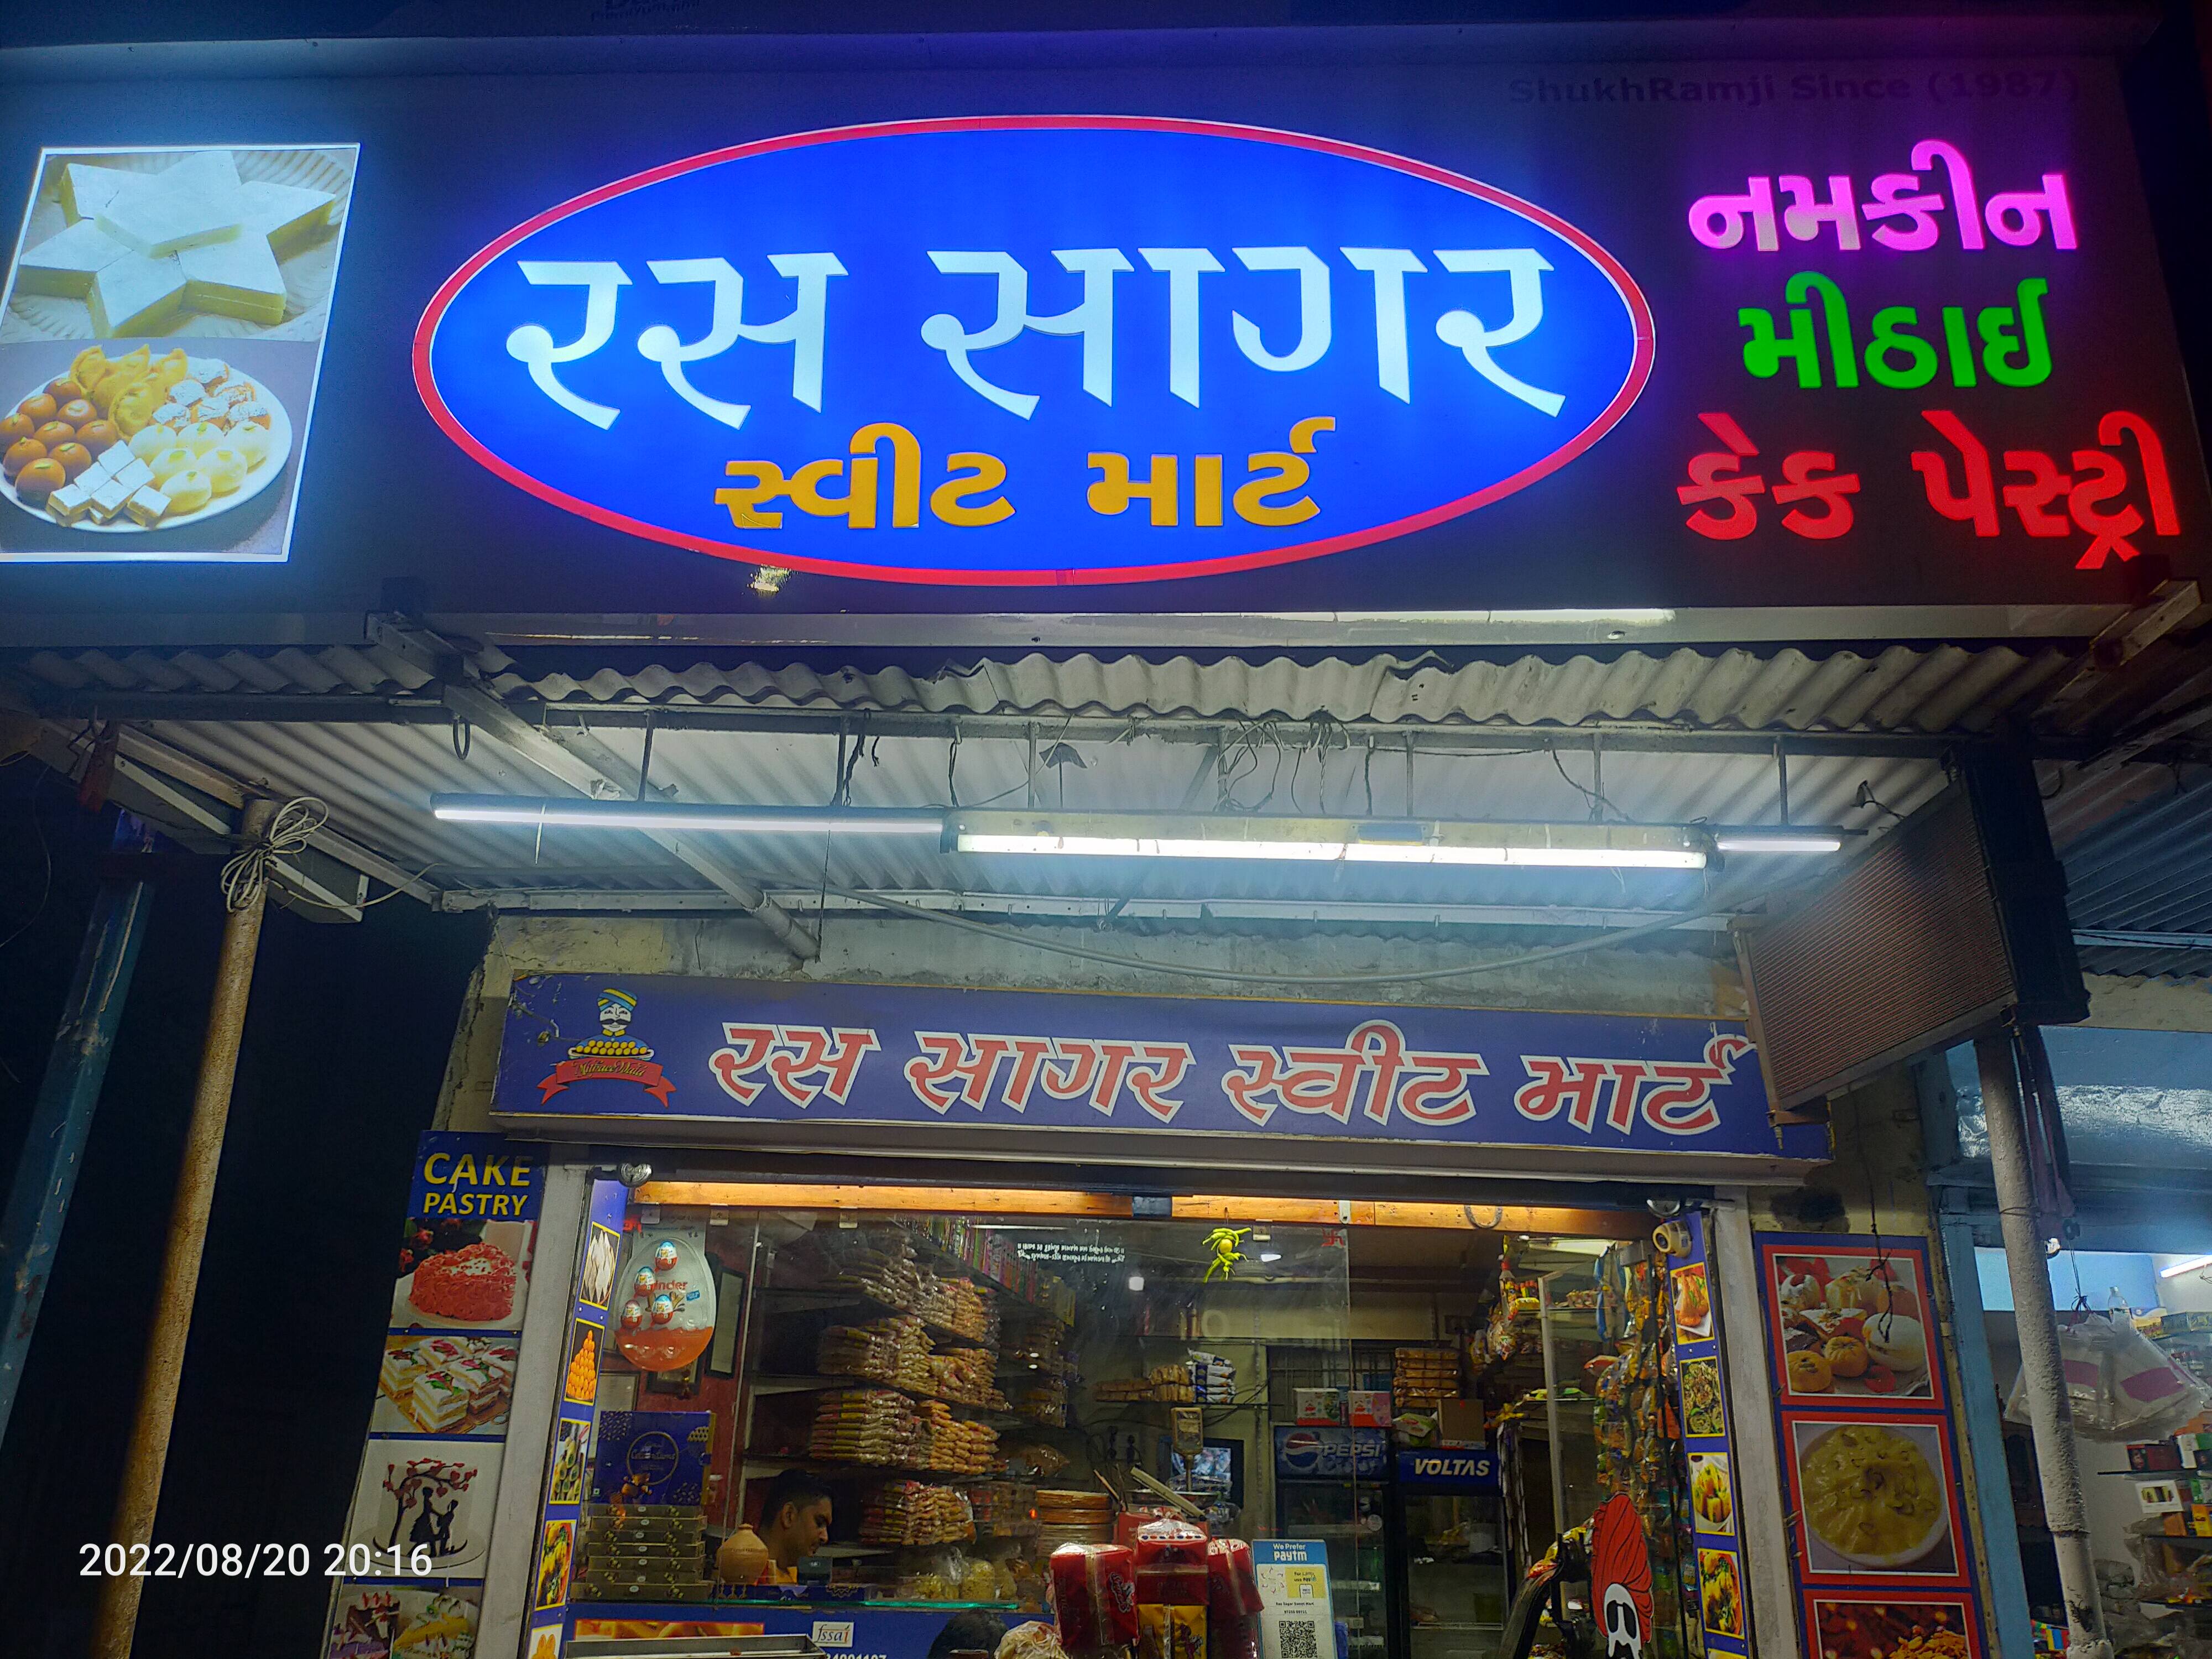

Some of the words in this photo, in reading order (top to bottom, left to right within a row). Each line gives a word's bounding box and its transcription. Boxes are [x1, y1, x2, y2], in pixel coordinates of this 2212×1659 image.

[1792, 74, 1911, 102] Since
[1928, 70, 2079, 104] (1987)
[1689, 139, 2077, 252] નમકીન
[1739, 273, 2051, 388] મીઠાઈ
[715, 424, 1014, 529] સ્વીટ
[1089, 418, 1334, 526] માર્ટ
[1677, 412, 1860, 540] કેક
[1911, 410, 2181, 570] પેસ્ટ્રી
[1221, 1020, 1490, 1126] स्वीट
[424, 1153, 532, 1188] CAKE
[423, 1192, 529, 1216] PASTRY
[1323, 1443, 1381, 1457] PEPSI
[1414, 1458, 1490, 1477] VOLTAS
[815, 1624, 851, 1644] fssai
